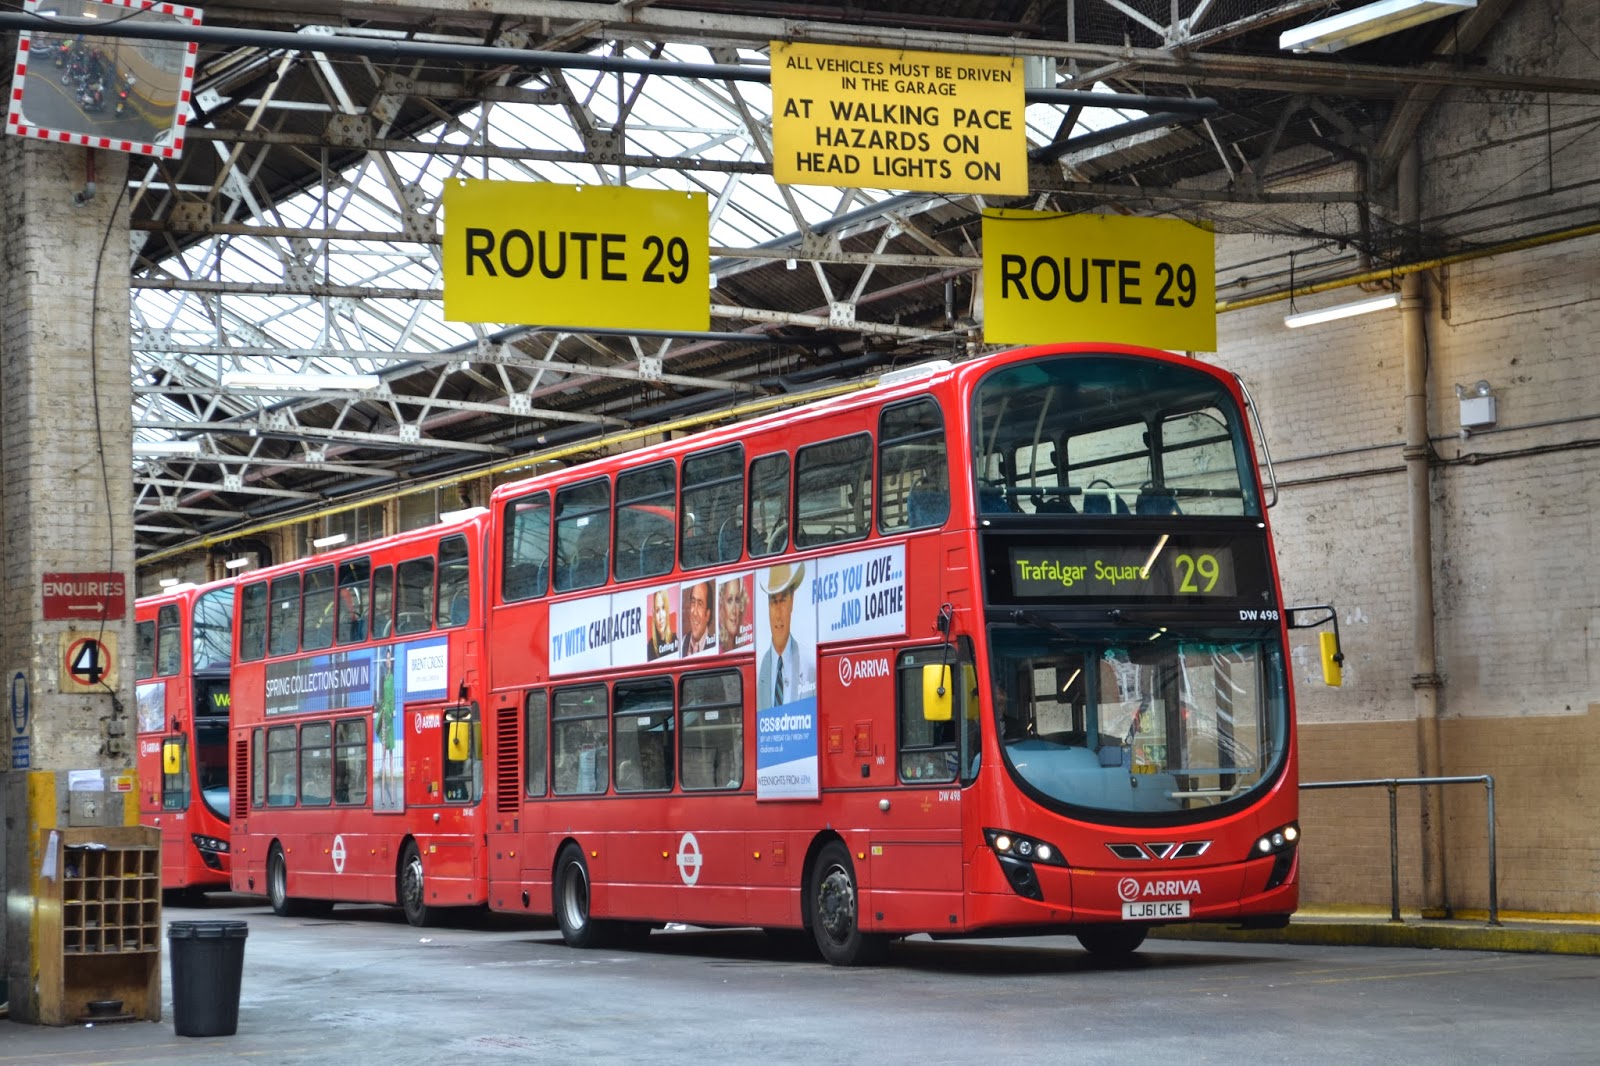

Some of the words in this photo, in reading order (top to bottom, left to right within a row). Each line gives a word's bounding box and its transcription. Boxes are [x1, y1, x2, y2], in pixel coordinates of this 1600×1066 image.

[786, 56, 812, 70] ALL
[816, 58, 884, 75] VEHICLES
[889, 63, 930, 78] MUST
[935, 65, 952, 80] BE
[957, 67, 1011, 82] DRIVEN
[842, 76, 857, 90] IN
[864, 78, 889, 92] THE
[895, 80, 956, 96] GARAGE
[783, 98, 813, 118] AT
[829, 100, 939, 126] WALKING
[953, 108, 1012, 130] PACE
[815, 126, 930, 152] HAZARDS
[943, 134, 979, 154] ON
[796, 152, 860, 174] HEAD
[873, 156, 952, 179] LIGHTS
[965, 161, 1001, 181] ON
[465, 228, 627, 281] ROUTE
[642, 235, 689, 284] 29
[1001, 254, 1142, 305] ROUTE
[1155, 262, 1196, 308] 29
[812, 571, 839, 605] FACES
[842, 564, 863, 595] YOU
[1016, 560, 1087, 587] Trafalgar
[1094, 562, 1150, 585] Square
[1175, 554, 1220, 593] 29
[43, 582, 123, 597] ENQUIRIES
[865, 585, 903, 621] LOATHE
[1239, 610, 1257, 621] DW
[1259, 610, 1279, 621] 498
[552, 633, 563, 662] TV
[565, 625, 586, 657] WITH
[589, 607, 641, 649] CHARACTER
[71, 639, 103, 684] 4
[854, 658, 890, 678] ARRIVA
[266, 677, 290, 698] SPRING
[291, 669, 339, 694] COLLECTIONS
[340, 667, 360, 687] NOW
[361, 665, 369, 684] IN
[422, 714, 440, 729] ARRIVA
[939, 791, 949, 801] DW
[950, 791, 961, 801] 498
[1142, 880, 1201, 896] ARRIVA
[1130, 904, 1156, 917] LJ61
[1160, 903, 1183, 916] CKE
